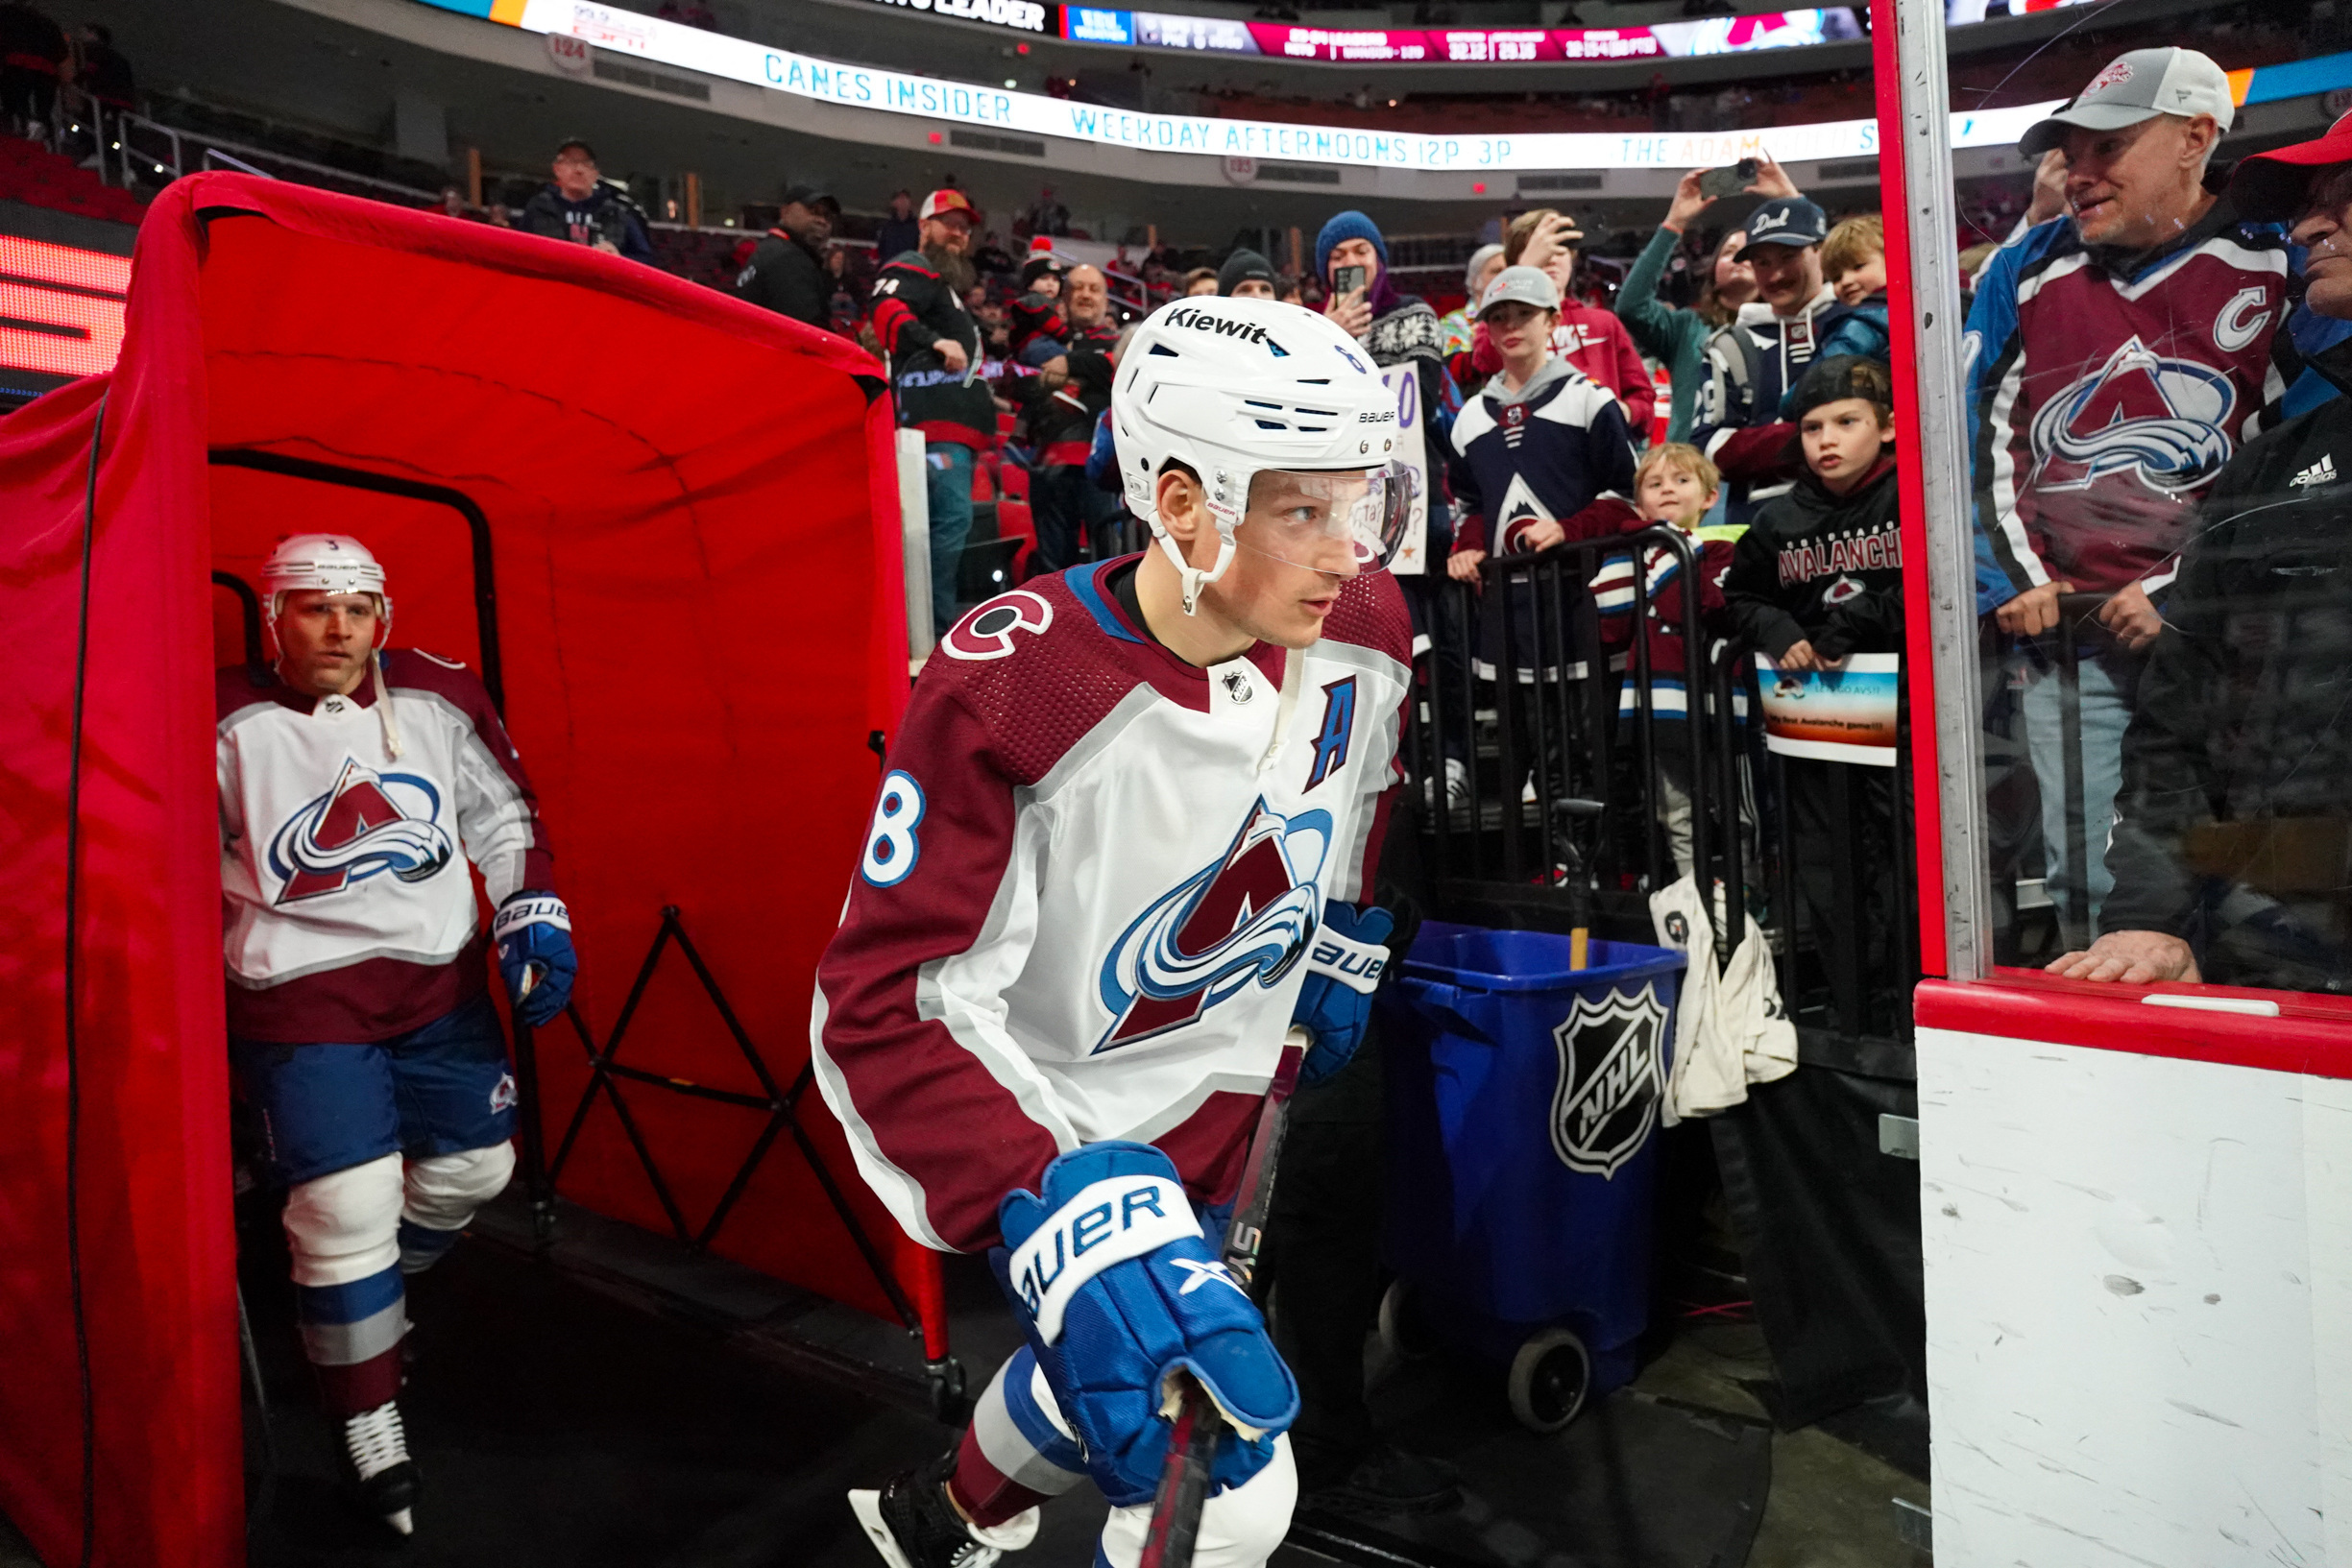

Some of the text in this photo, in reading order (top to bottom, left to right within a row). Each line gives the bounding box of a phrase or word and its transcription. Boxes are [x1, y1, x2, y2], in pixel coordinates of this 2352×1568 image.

[934, 0, 1046, 32] LEADER
[765, 54, 1010, 122] CANES INSIDER
[1071, 108, 1511, 165] WEEKDAY AFTERNOONS 12P 3P
[1622, 138, 1669, 162] THE
[1681, 134, 1760, 162] ADAM
[1164, 307, 1270, 345] Kiewit
[2213, 285, 2271, 352] C
[1358, 411, 1395, 423] BAUER
[1207, 502, 1236, 516] BAUER
[1787, 520, 1895, 548] COLORADO
[1779, 527, 1903, 591] AVALANCH
[1301, 674, 1356, 795] A
[1801, 717, 1845, 728] Avalanche
[861, 769, 926, 888] 8
[496, 903, 570, 931] BAUE
[1311, 940, 1383, 980] AUE
[1579, 1032, 1649, 1143] NHL
[1023, 1186, 1166, 1322] AUER
